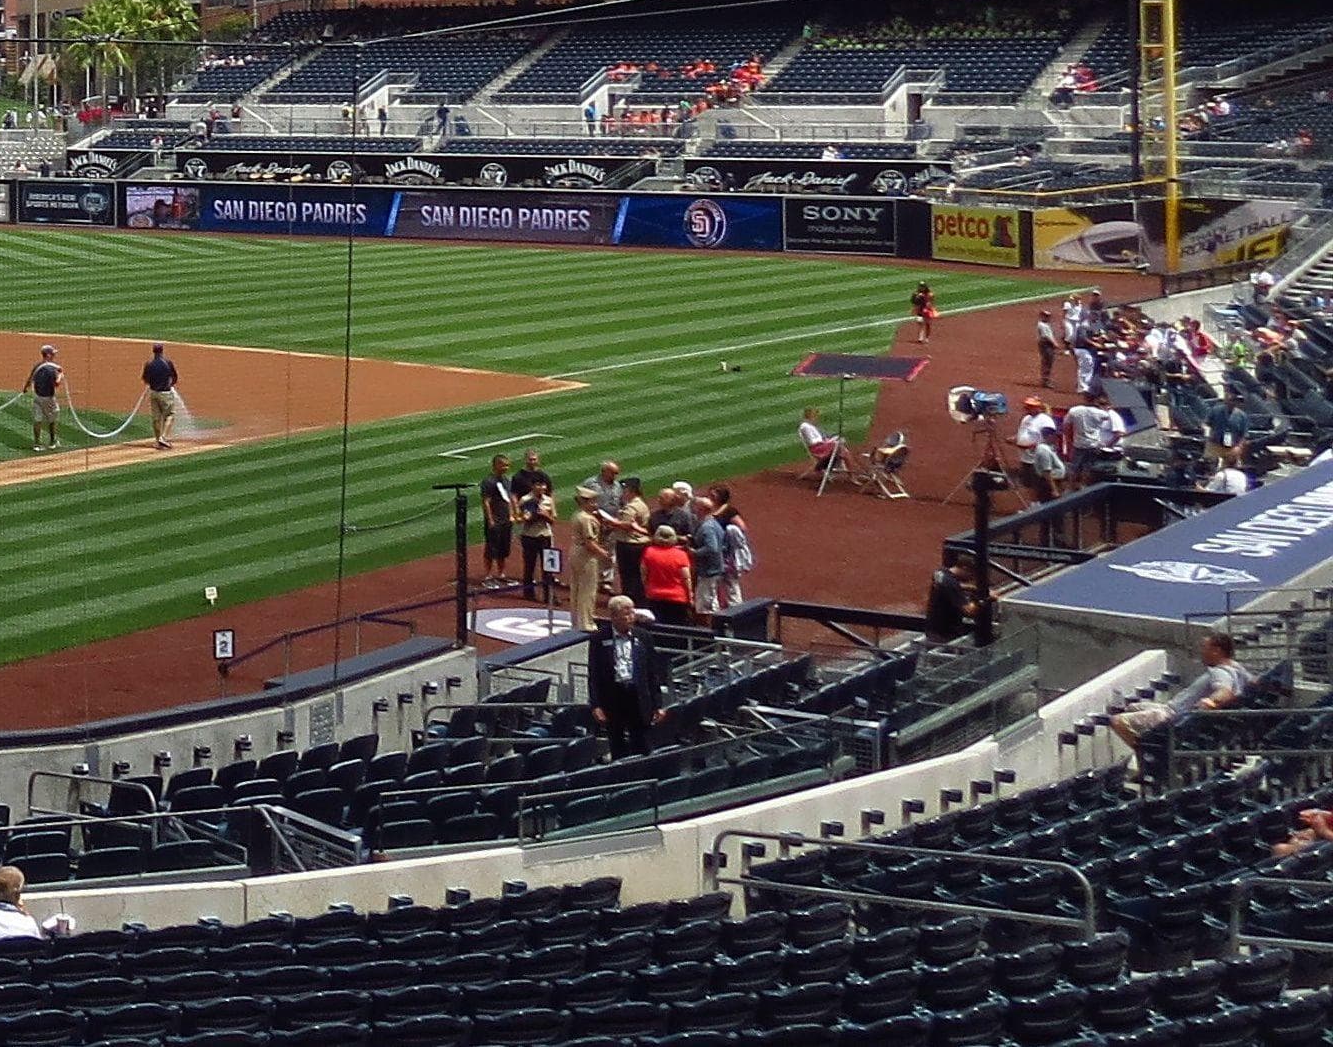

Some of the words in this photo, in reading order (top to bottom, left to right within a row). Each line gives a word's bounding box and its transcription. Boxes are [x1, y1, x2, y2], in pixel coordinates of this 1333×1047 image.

[213, 199, 244, 220] SAN
[247, 200, 298, 222] DIEGO
[301, 202, 368, 224] PADRES
[420, 204, 454, 227] SAN
[459, 206, 514, 229] DIEGO
[518, 208, 591, 231] PADRES
[802, 205, 884, 222] SONY
[933, 212, 990, 240] petco
